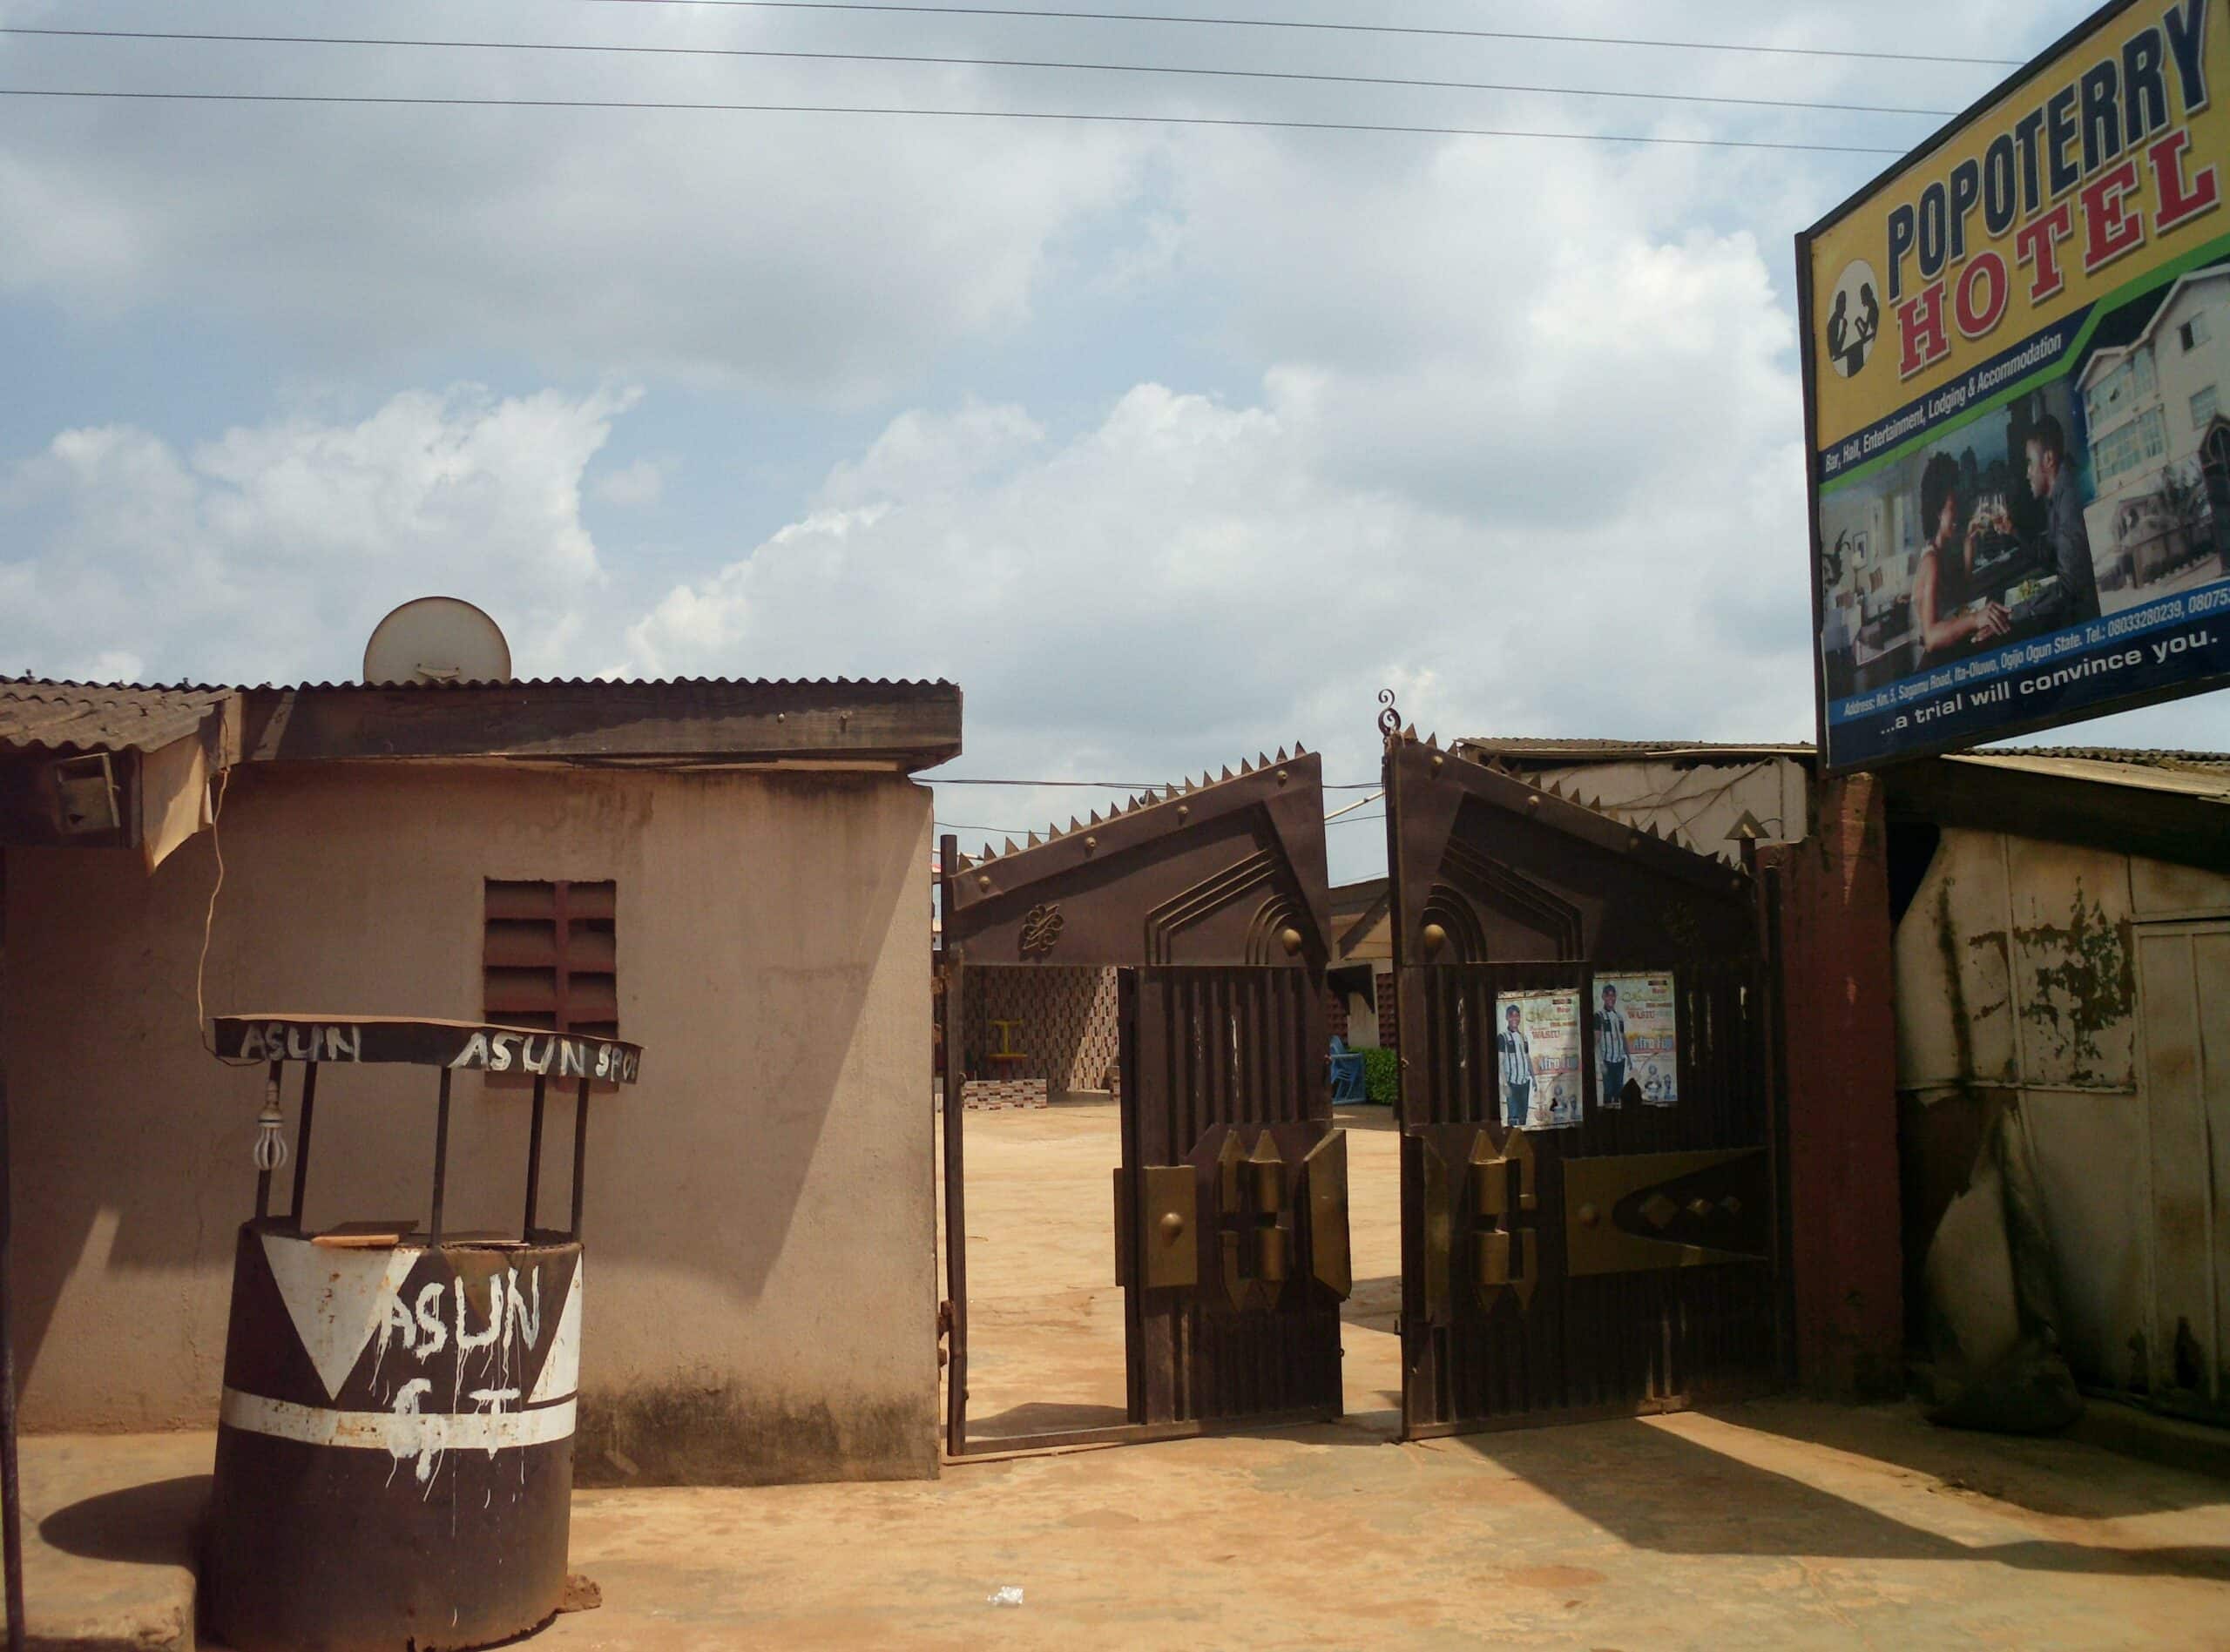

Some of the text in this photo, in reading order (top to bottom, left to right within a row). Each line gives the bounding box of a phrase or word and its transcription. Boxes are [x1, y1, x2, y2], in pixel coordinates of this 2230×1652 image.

[1886, 0, 2208, 305] POPOTERRY
[1896, 129, 2221, 381] HOTEL
[1863, 405, 1927, 454] Entertainment,
[1928, 386, 1967, 419] Lodging
[1967, 376, 1976, 398] &
[1977, 333, 2063, 394] Accommodation
[2025, 644, 2052, 664] Ogun
[2187, 586, 2230, 614] 08075
[1914, 693, 1963, 725] trial
[1970, 680, 2010, 706] will
[2019, 649, 2143, 695] convince
[2151, 630, 2219, 664] you.
[240, 1023, 362, 1063] ASUN
[447, 1032, 585, 1077] ASUN
[376, 1265, 540, 1360] ASUN
